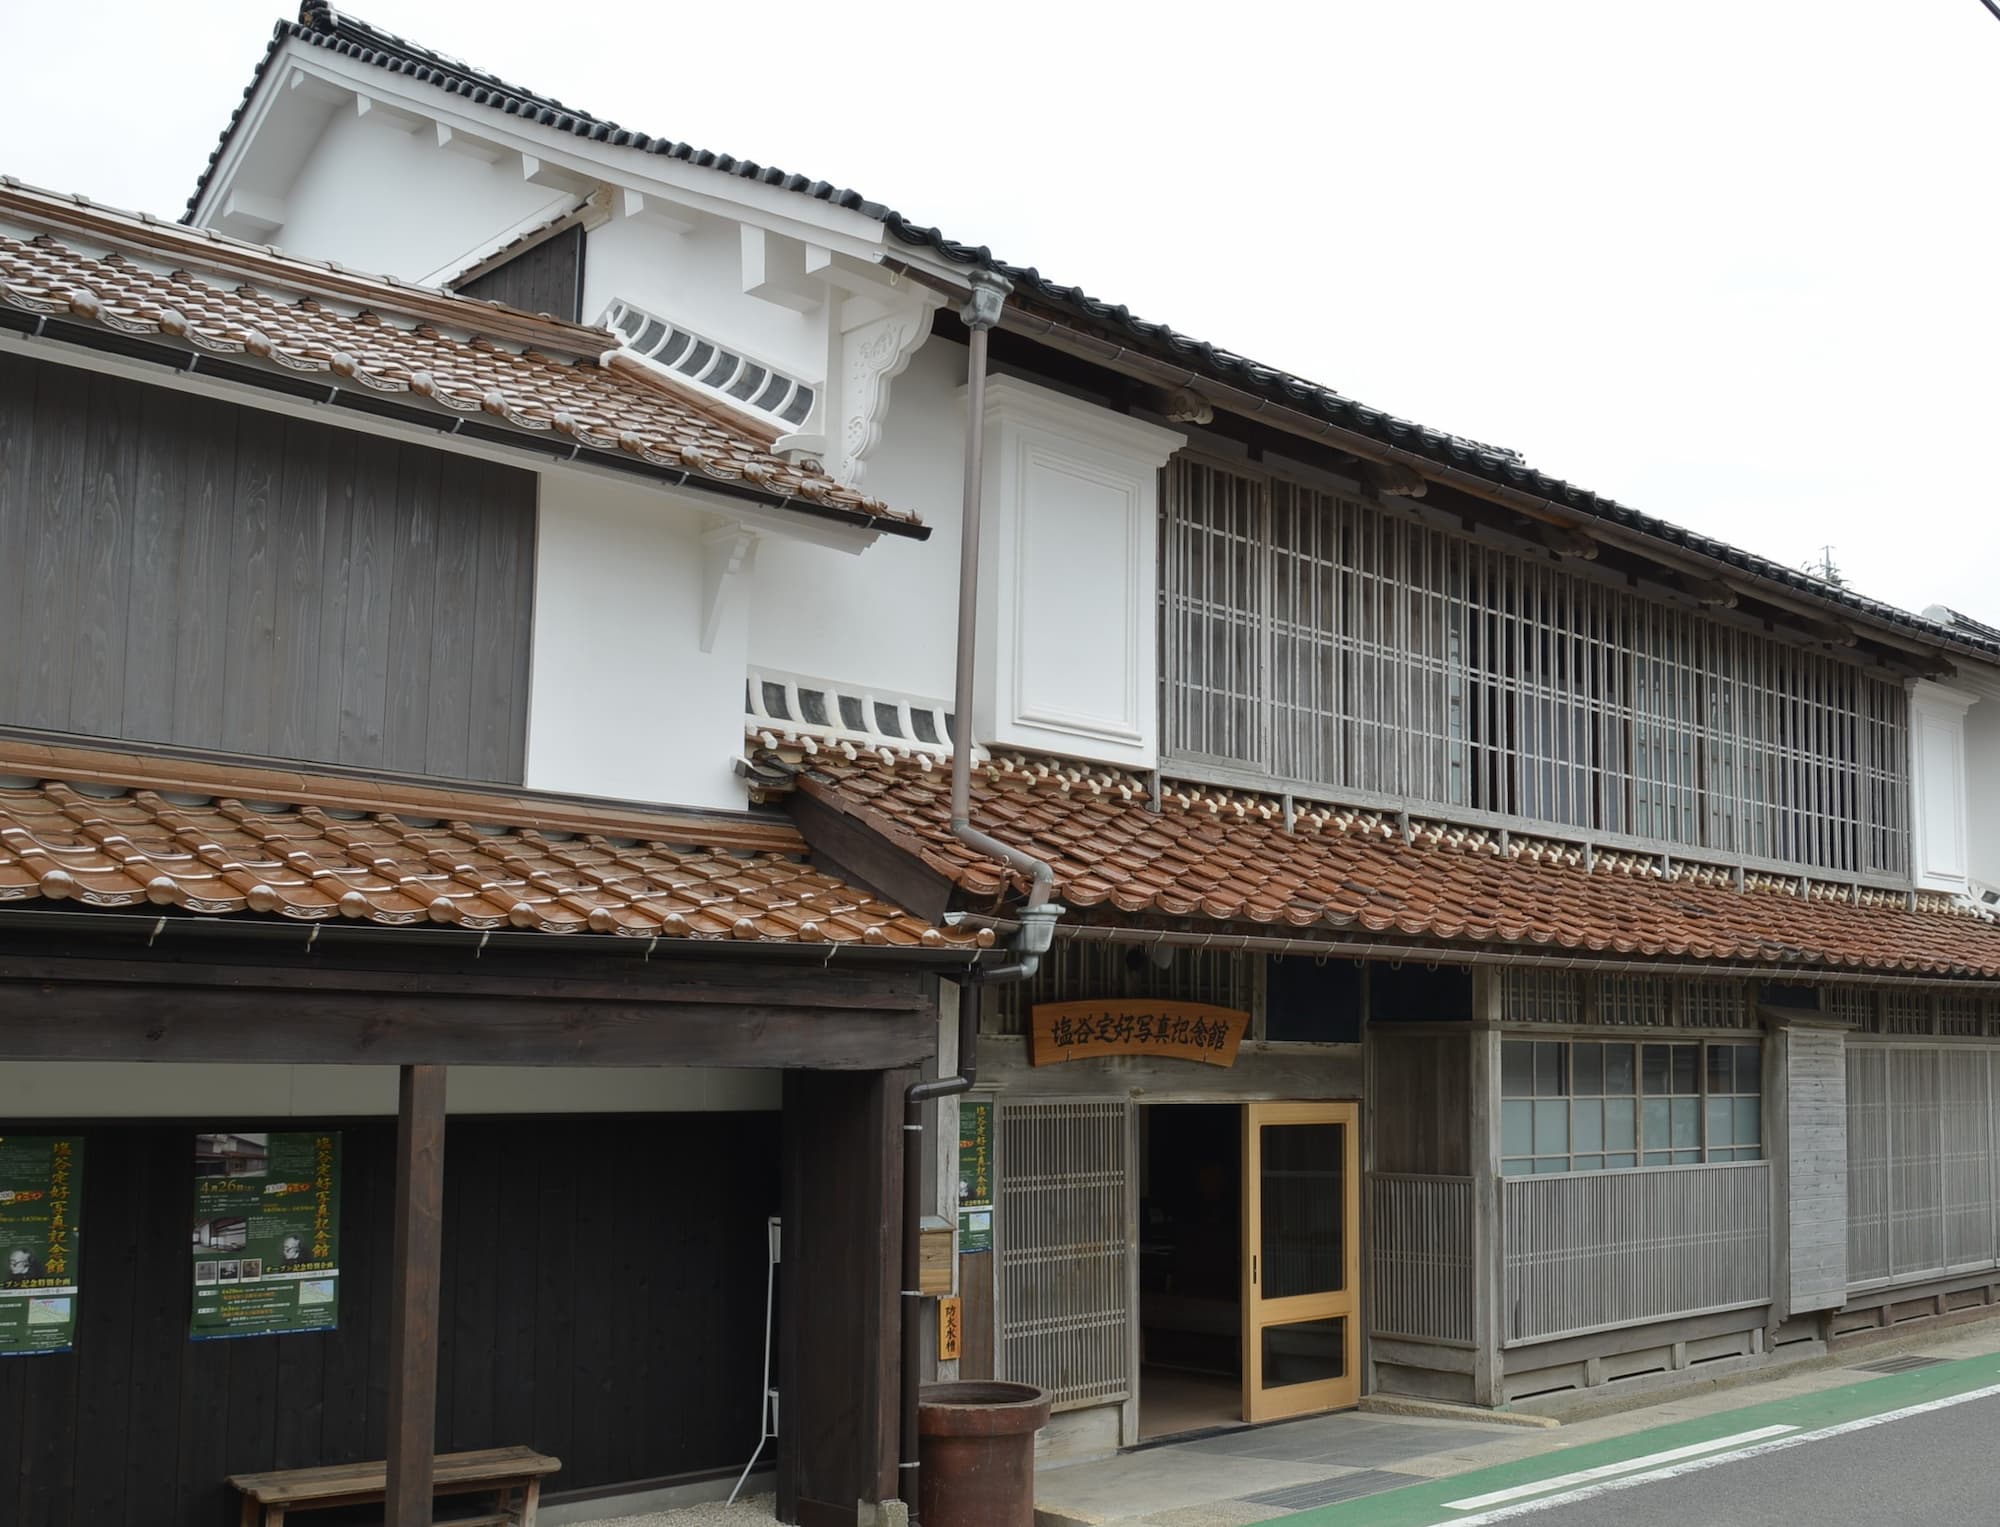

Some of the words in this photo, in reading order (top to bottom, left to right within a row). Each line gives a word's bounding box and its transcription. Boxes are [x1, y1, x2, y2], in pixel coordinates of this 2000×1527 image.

[1051, 1012, 1229, 1050] 塩谷定好写真記念館
[44, 1141, 73, 1275] 塩谷定好写真記念館
[311, 1136, 334, 1258] 塩谷定好写真記念館
[945, 1304, 957, 1353] 防火水槽
